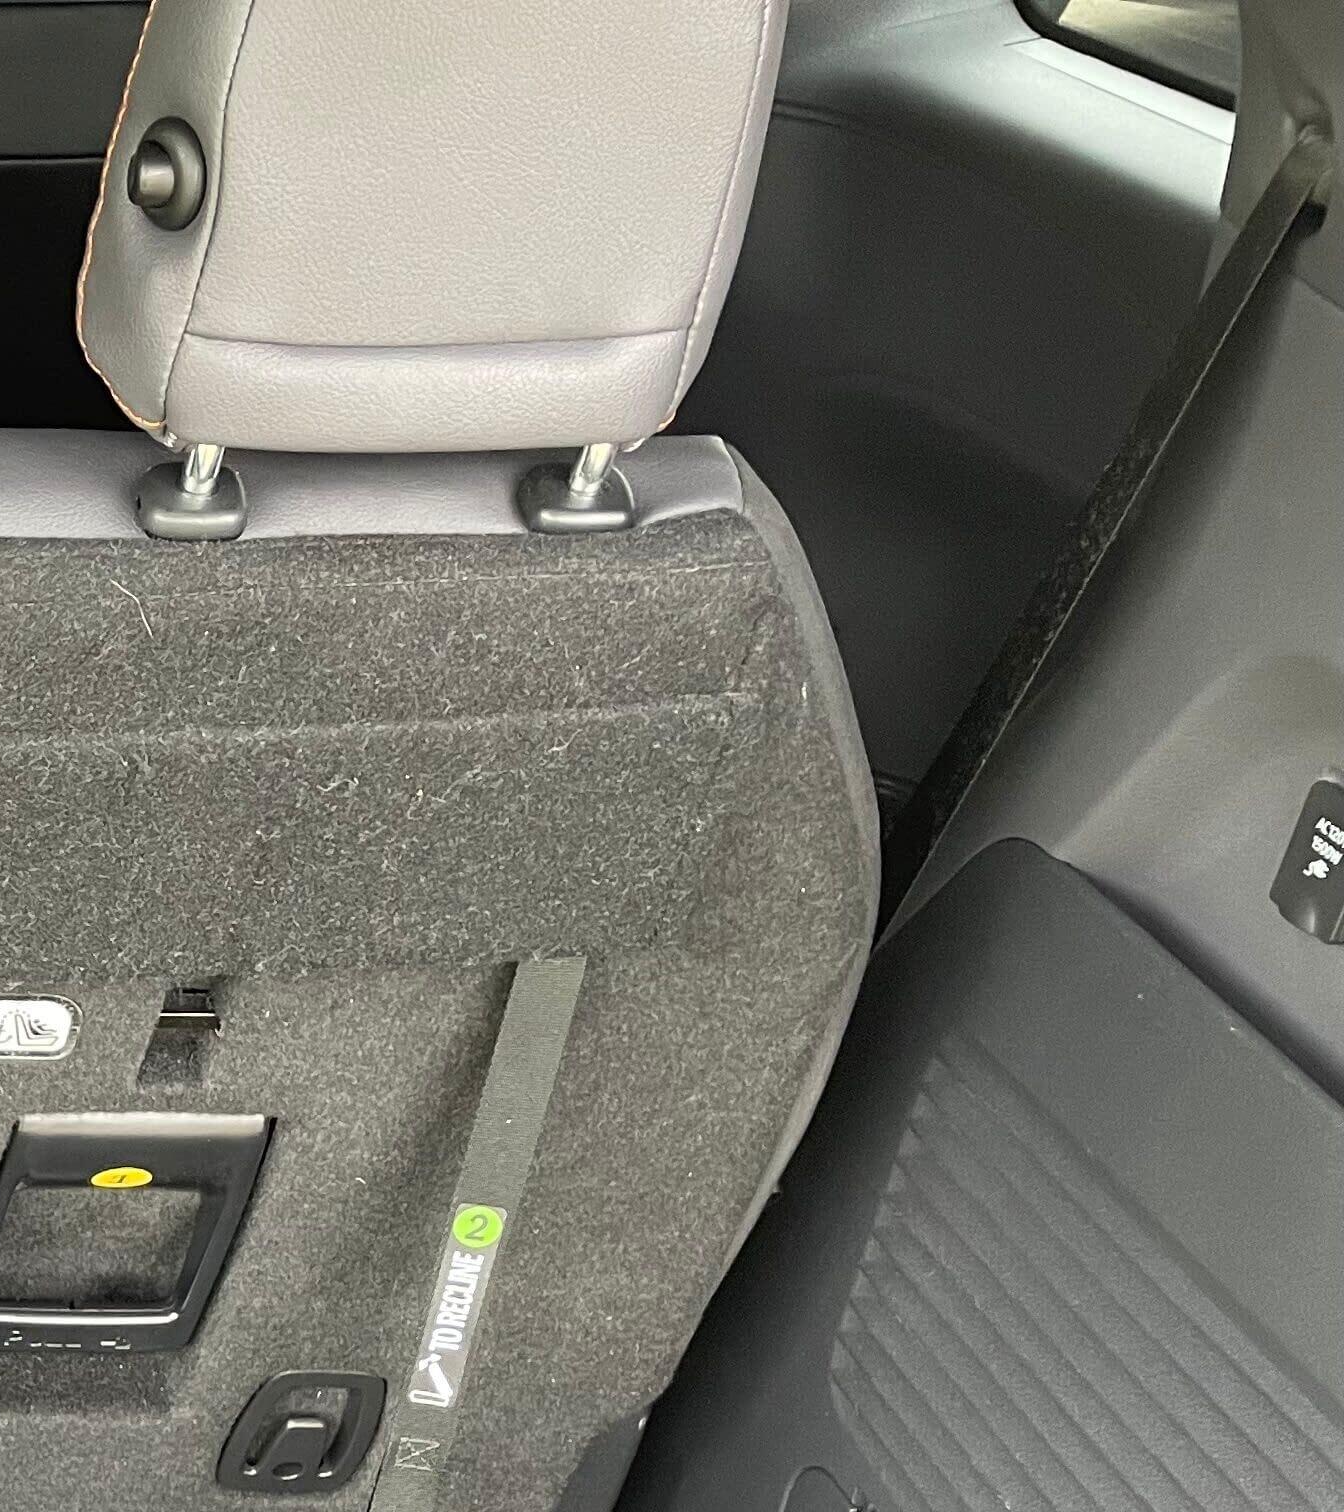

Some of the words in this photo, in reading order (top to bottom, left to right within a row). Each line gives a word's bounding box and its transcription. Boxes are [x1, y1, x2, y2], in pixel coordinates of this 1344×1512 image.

[465, 1214, 489, 1241] 2
[436, 1250, 485, 1329] RECLINE
[429, 1327, 463, 1351] TO
